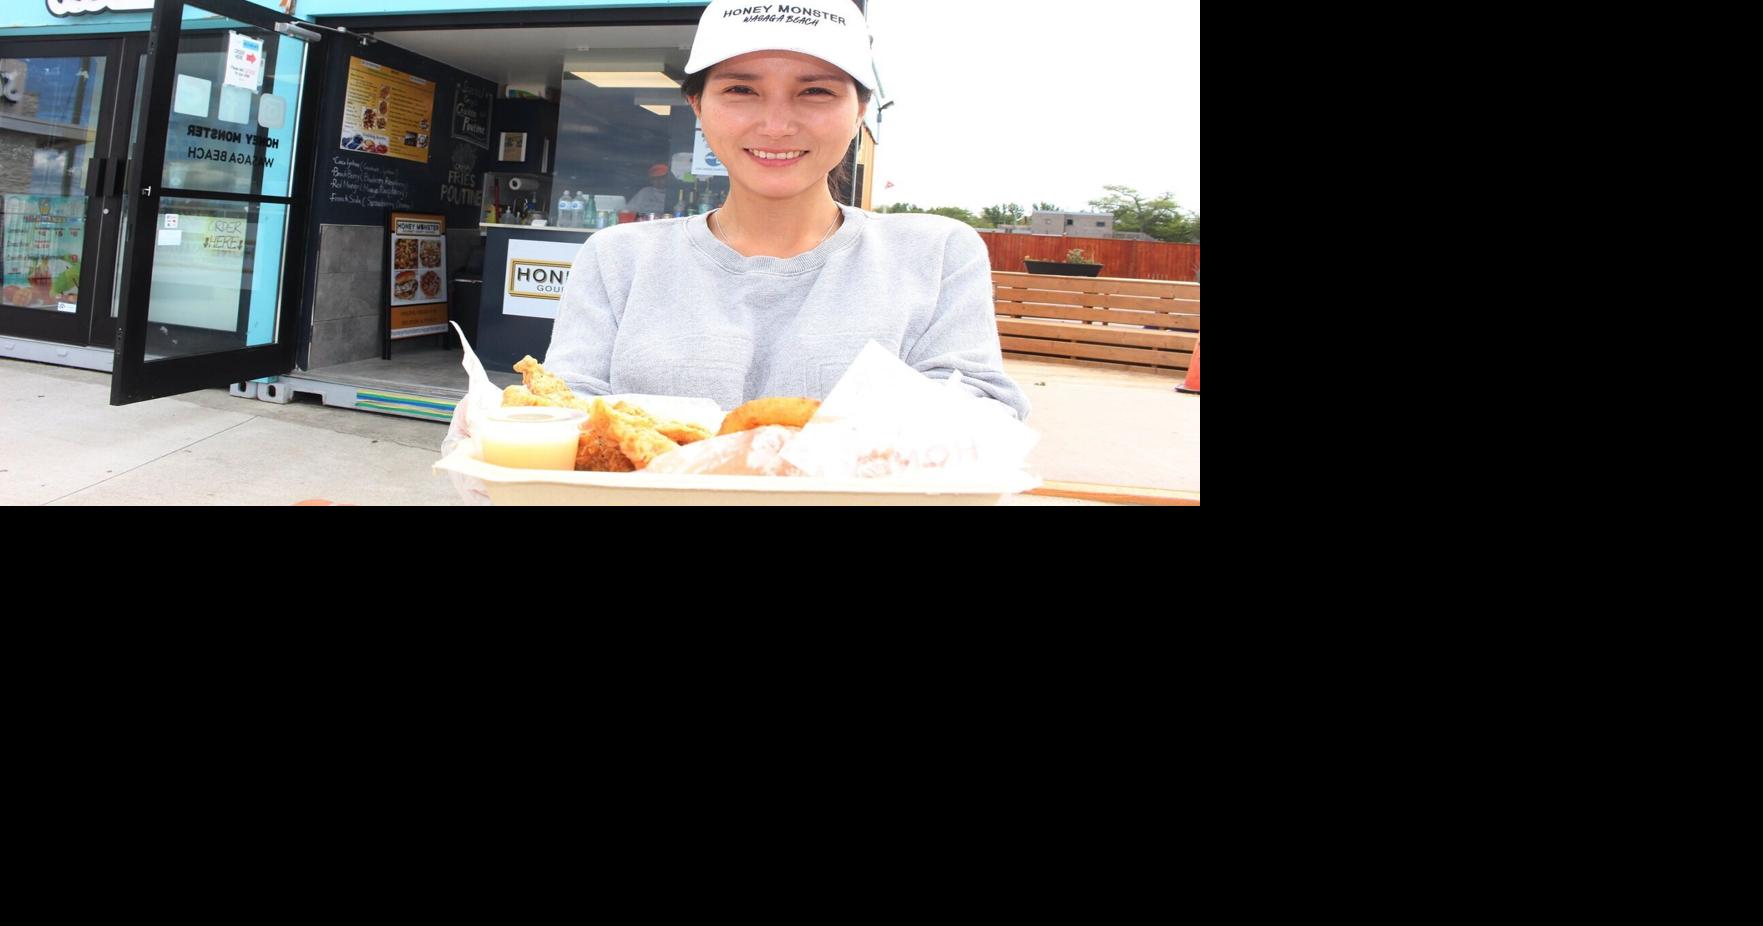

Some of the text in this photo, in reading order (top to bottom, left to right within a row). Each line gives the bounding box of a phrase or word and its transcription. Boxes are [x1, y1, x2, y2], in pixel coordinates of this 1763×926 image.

[723, 4, 846, 26] HONEY MONSTER
[743, 14, 819, 27] WASAGA BEACH
[517, 267, 569, 285] HON
